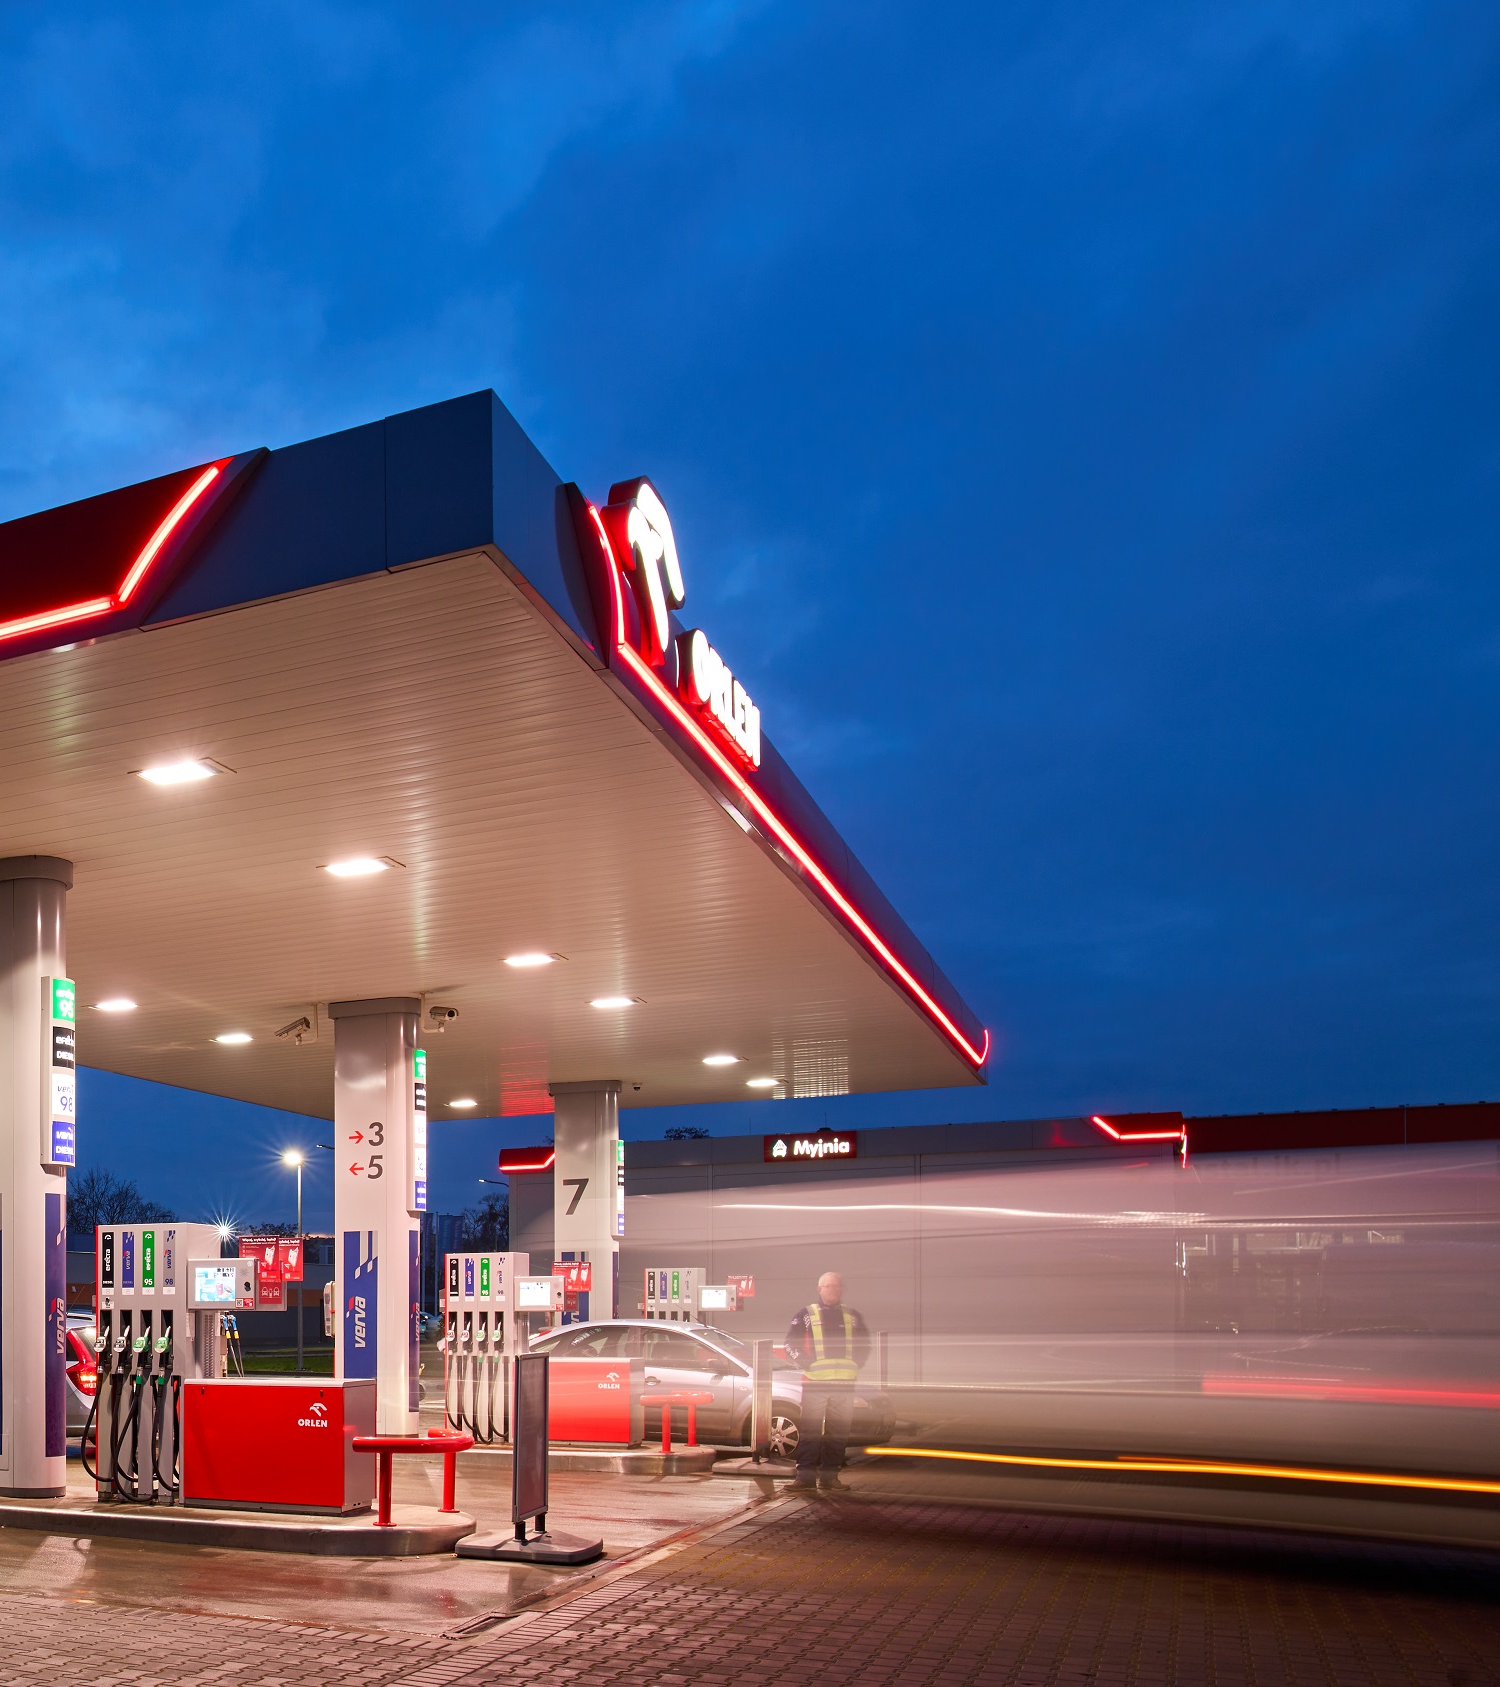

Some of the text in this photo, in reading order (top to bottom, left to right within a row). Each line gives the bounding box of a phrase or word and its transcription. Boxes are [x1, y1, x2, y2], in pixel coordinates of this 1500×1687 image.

[691, 629, 760, 767] ORLEN
[368, 1121, 385, 1147] 3
[793, 1137, 850, 1158] Myjnia
[367, 1154, 384, 1180] 5
[562, 1178, 590, 1215] 7
[144, 1278, 153, 1286] 95
[164, 1278, 174, 1286] 98
[56, 1297, 64, 1355] verva
[354, 1295, 366, 1348] verva
[297, 1418, 328, 1428] ORLEN
